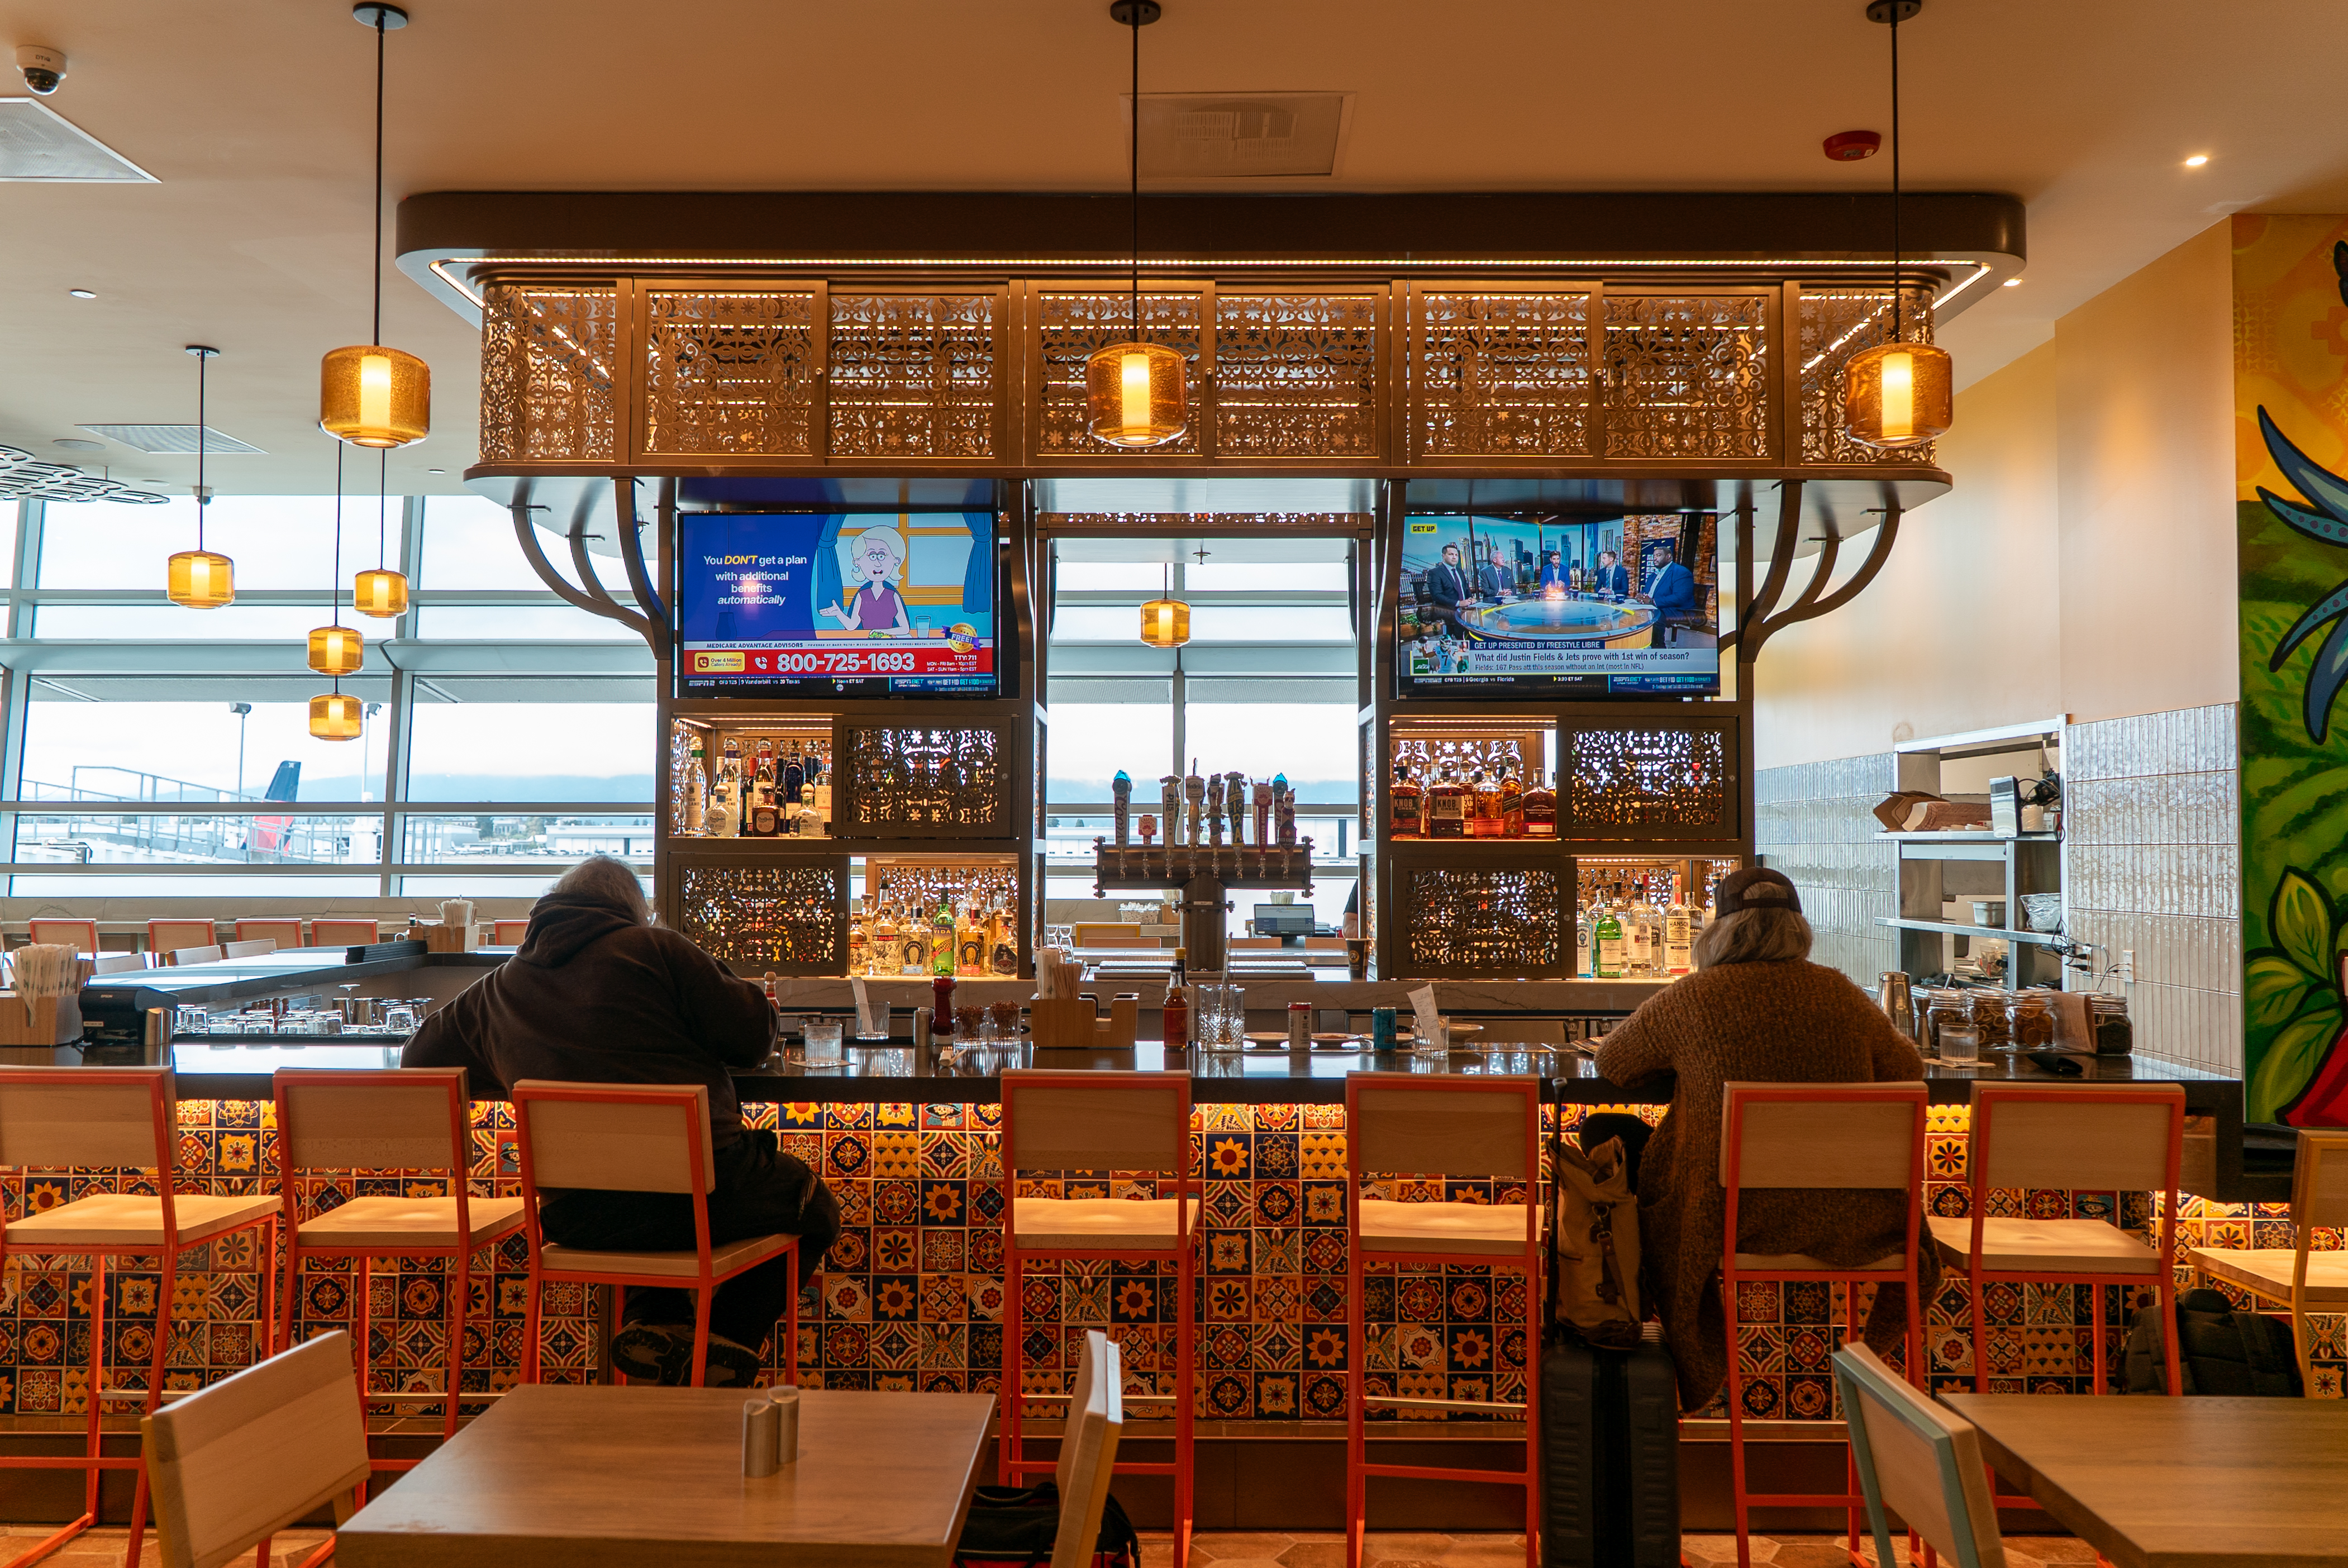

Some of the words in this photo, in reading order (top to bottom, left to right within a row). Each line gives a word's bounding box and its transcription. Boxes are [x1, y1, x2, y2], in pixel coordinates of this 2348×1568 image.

[703, 555, 723, 565] You
[724, 555, 758, 565] DON'T
[759, 556, 776, 567] get
[785, 555, 807, 566] plan
[715, 571, 737, 581] with
[739, 571, 789, 581] additional
[731, 583, 773, 593] benefits
[717, 594, 786, 606] automatically
[951, 633, 973, 644] FREE!
[777, 652, 915, 672] 800-725-1693
[1441, 655, 1449, 666] 7
[1475, 653, 1494, 662] What
[1496, 653, 1507, 661] did
[1509, 653, 1531, 661] Justin
[1533, 652, 1555, 661] Fields
[1565, 652, 1580, 661] Jets
[1582, 654, 1602, 662] prove
[1650, 652, 1658, 660] of
[1659, 652, 1689, 660] season?
[1166, 792, 1174, 812] PILS
[1394, 798, 1413, 807] KNOB
[1437, 799, 1456, 808] KNOB
[1115, 795, 1127, 838] Coors
[1232, 802, 1243, 842] IPA
